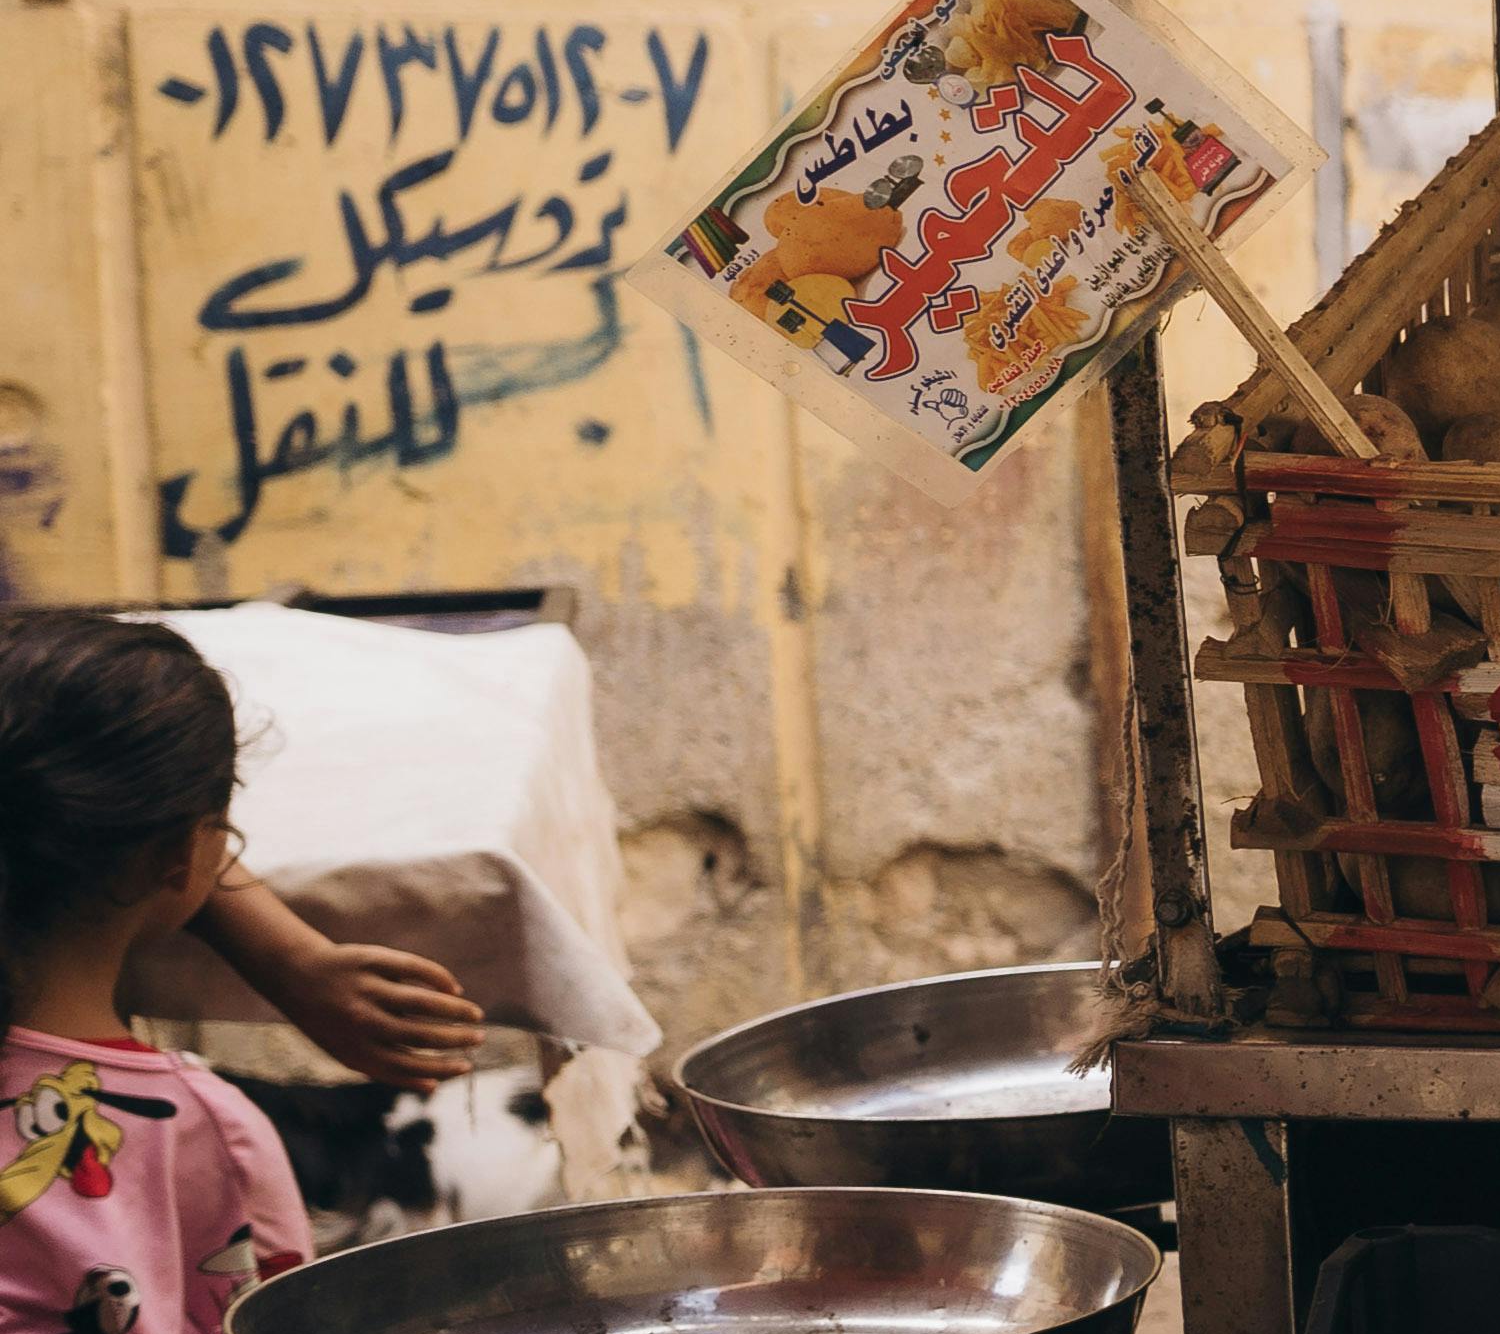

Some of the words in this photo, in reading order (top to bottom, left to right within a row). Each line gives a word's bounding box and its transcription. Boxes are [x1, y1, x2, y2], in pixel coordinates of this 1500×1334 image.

[797, 99, 918, 204] بطاطس
[842, 33, 1136, 381] للتحمير
[1070, 231, 1084, 255] و
